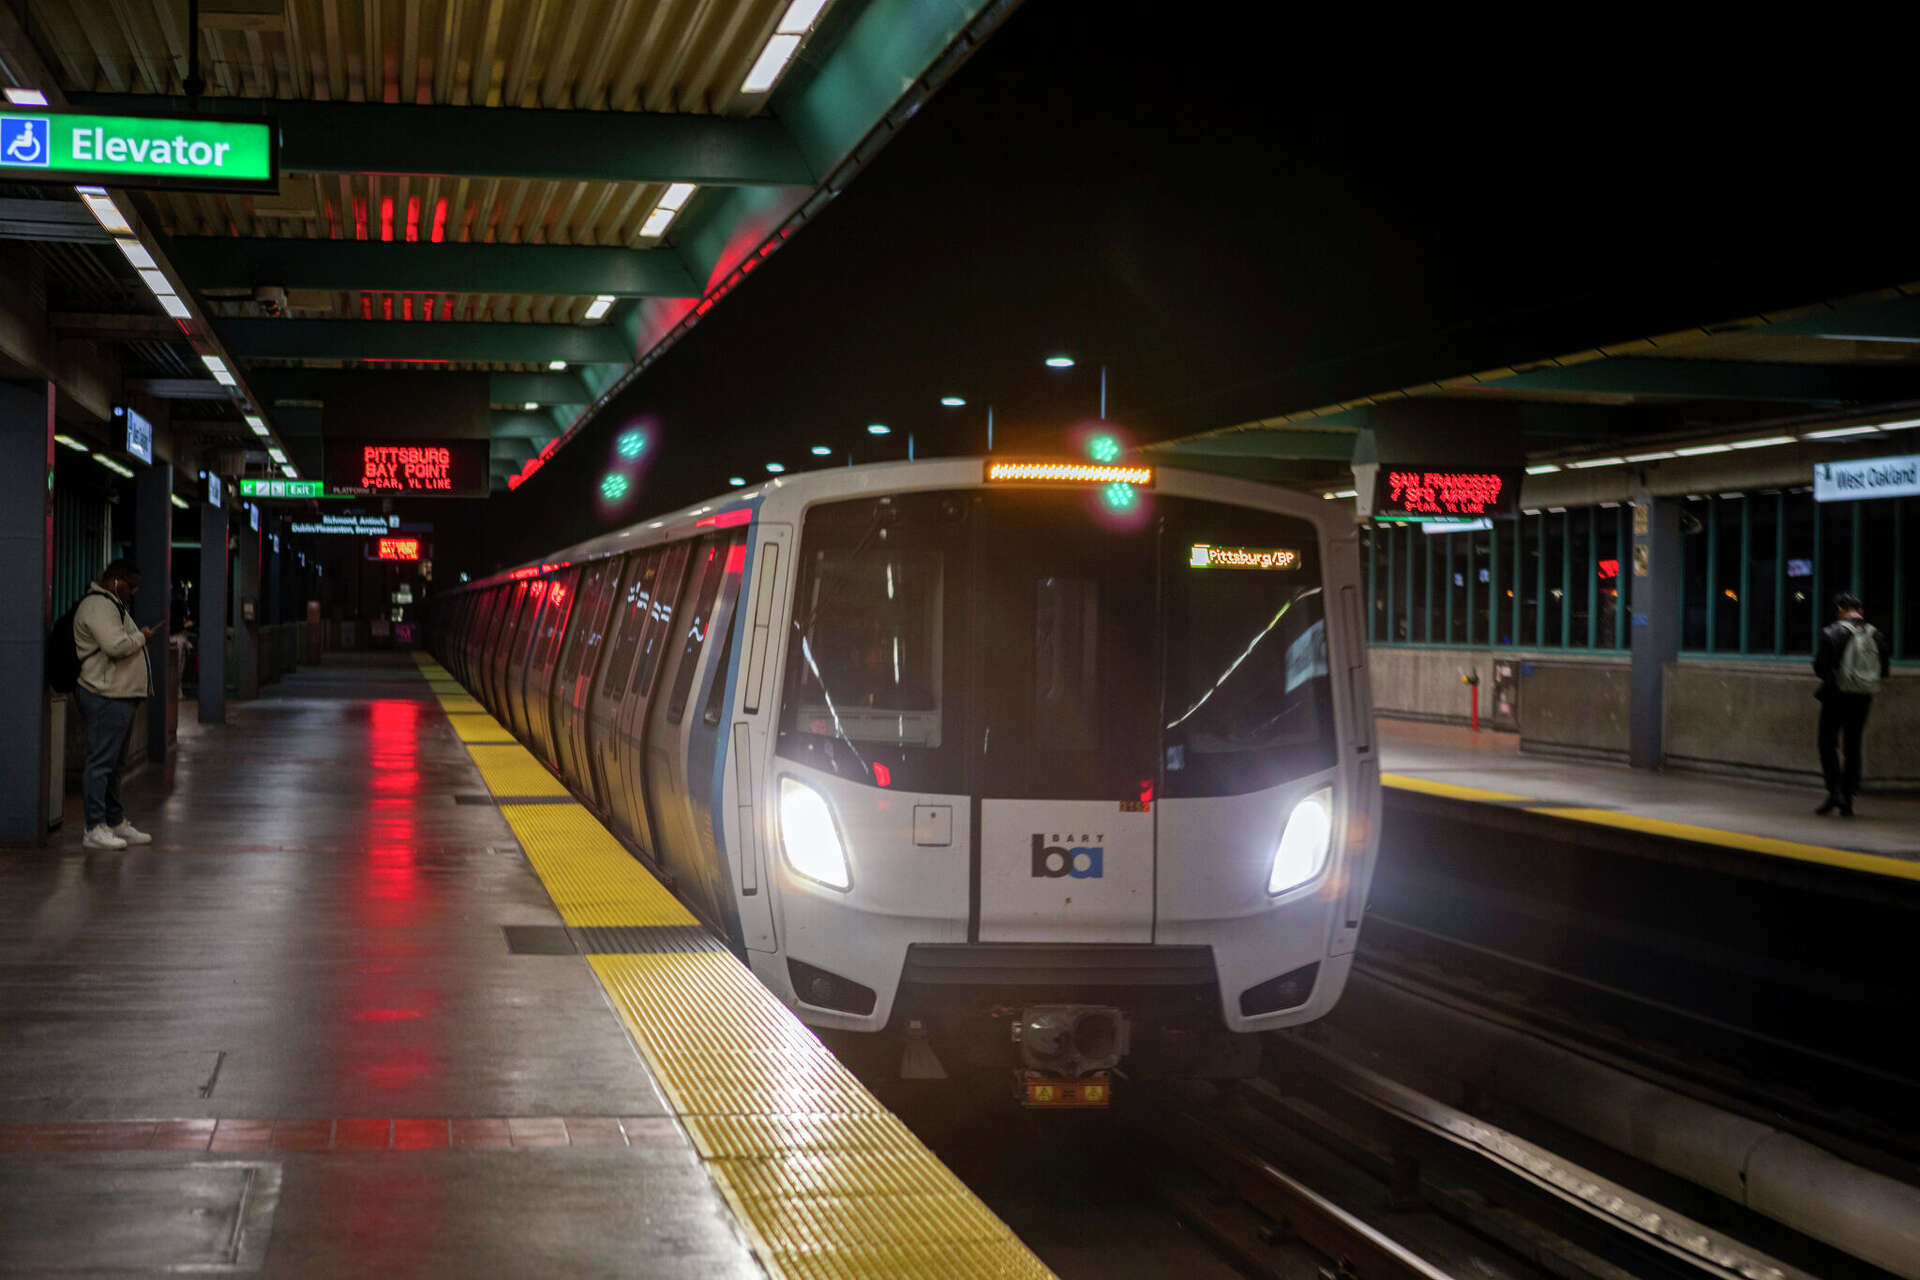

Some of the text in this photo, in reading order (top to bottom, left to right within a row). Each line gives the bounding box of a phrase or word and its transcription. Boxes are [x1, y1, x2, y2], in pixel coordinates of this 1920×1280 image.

[72, 127, 230, 167] Elevator
[364, 446, 450, 464] PITTSBURG
[365, 462, 449, 479] BAY POINT
[290, 484, 310, 495] Exit
[425, 478, 451, 489] LINE
[1389, 472, 1502, 491] SAN FRANCISCO
[1209, 548, 1294, 568] Pittsburg/BP
[1052, 834, 1104, 842] BART
